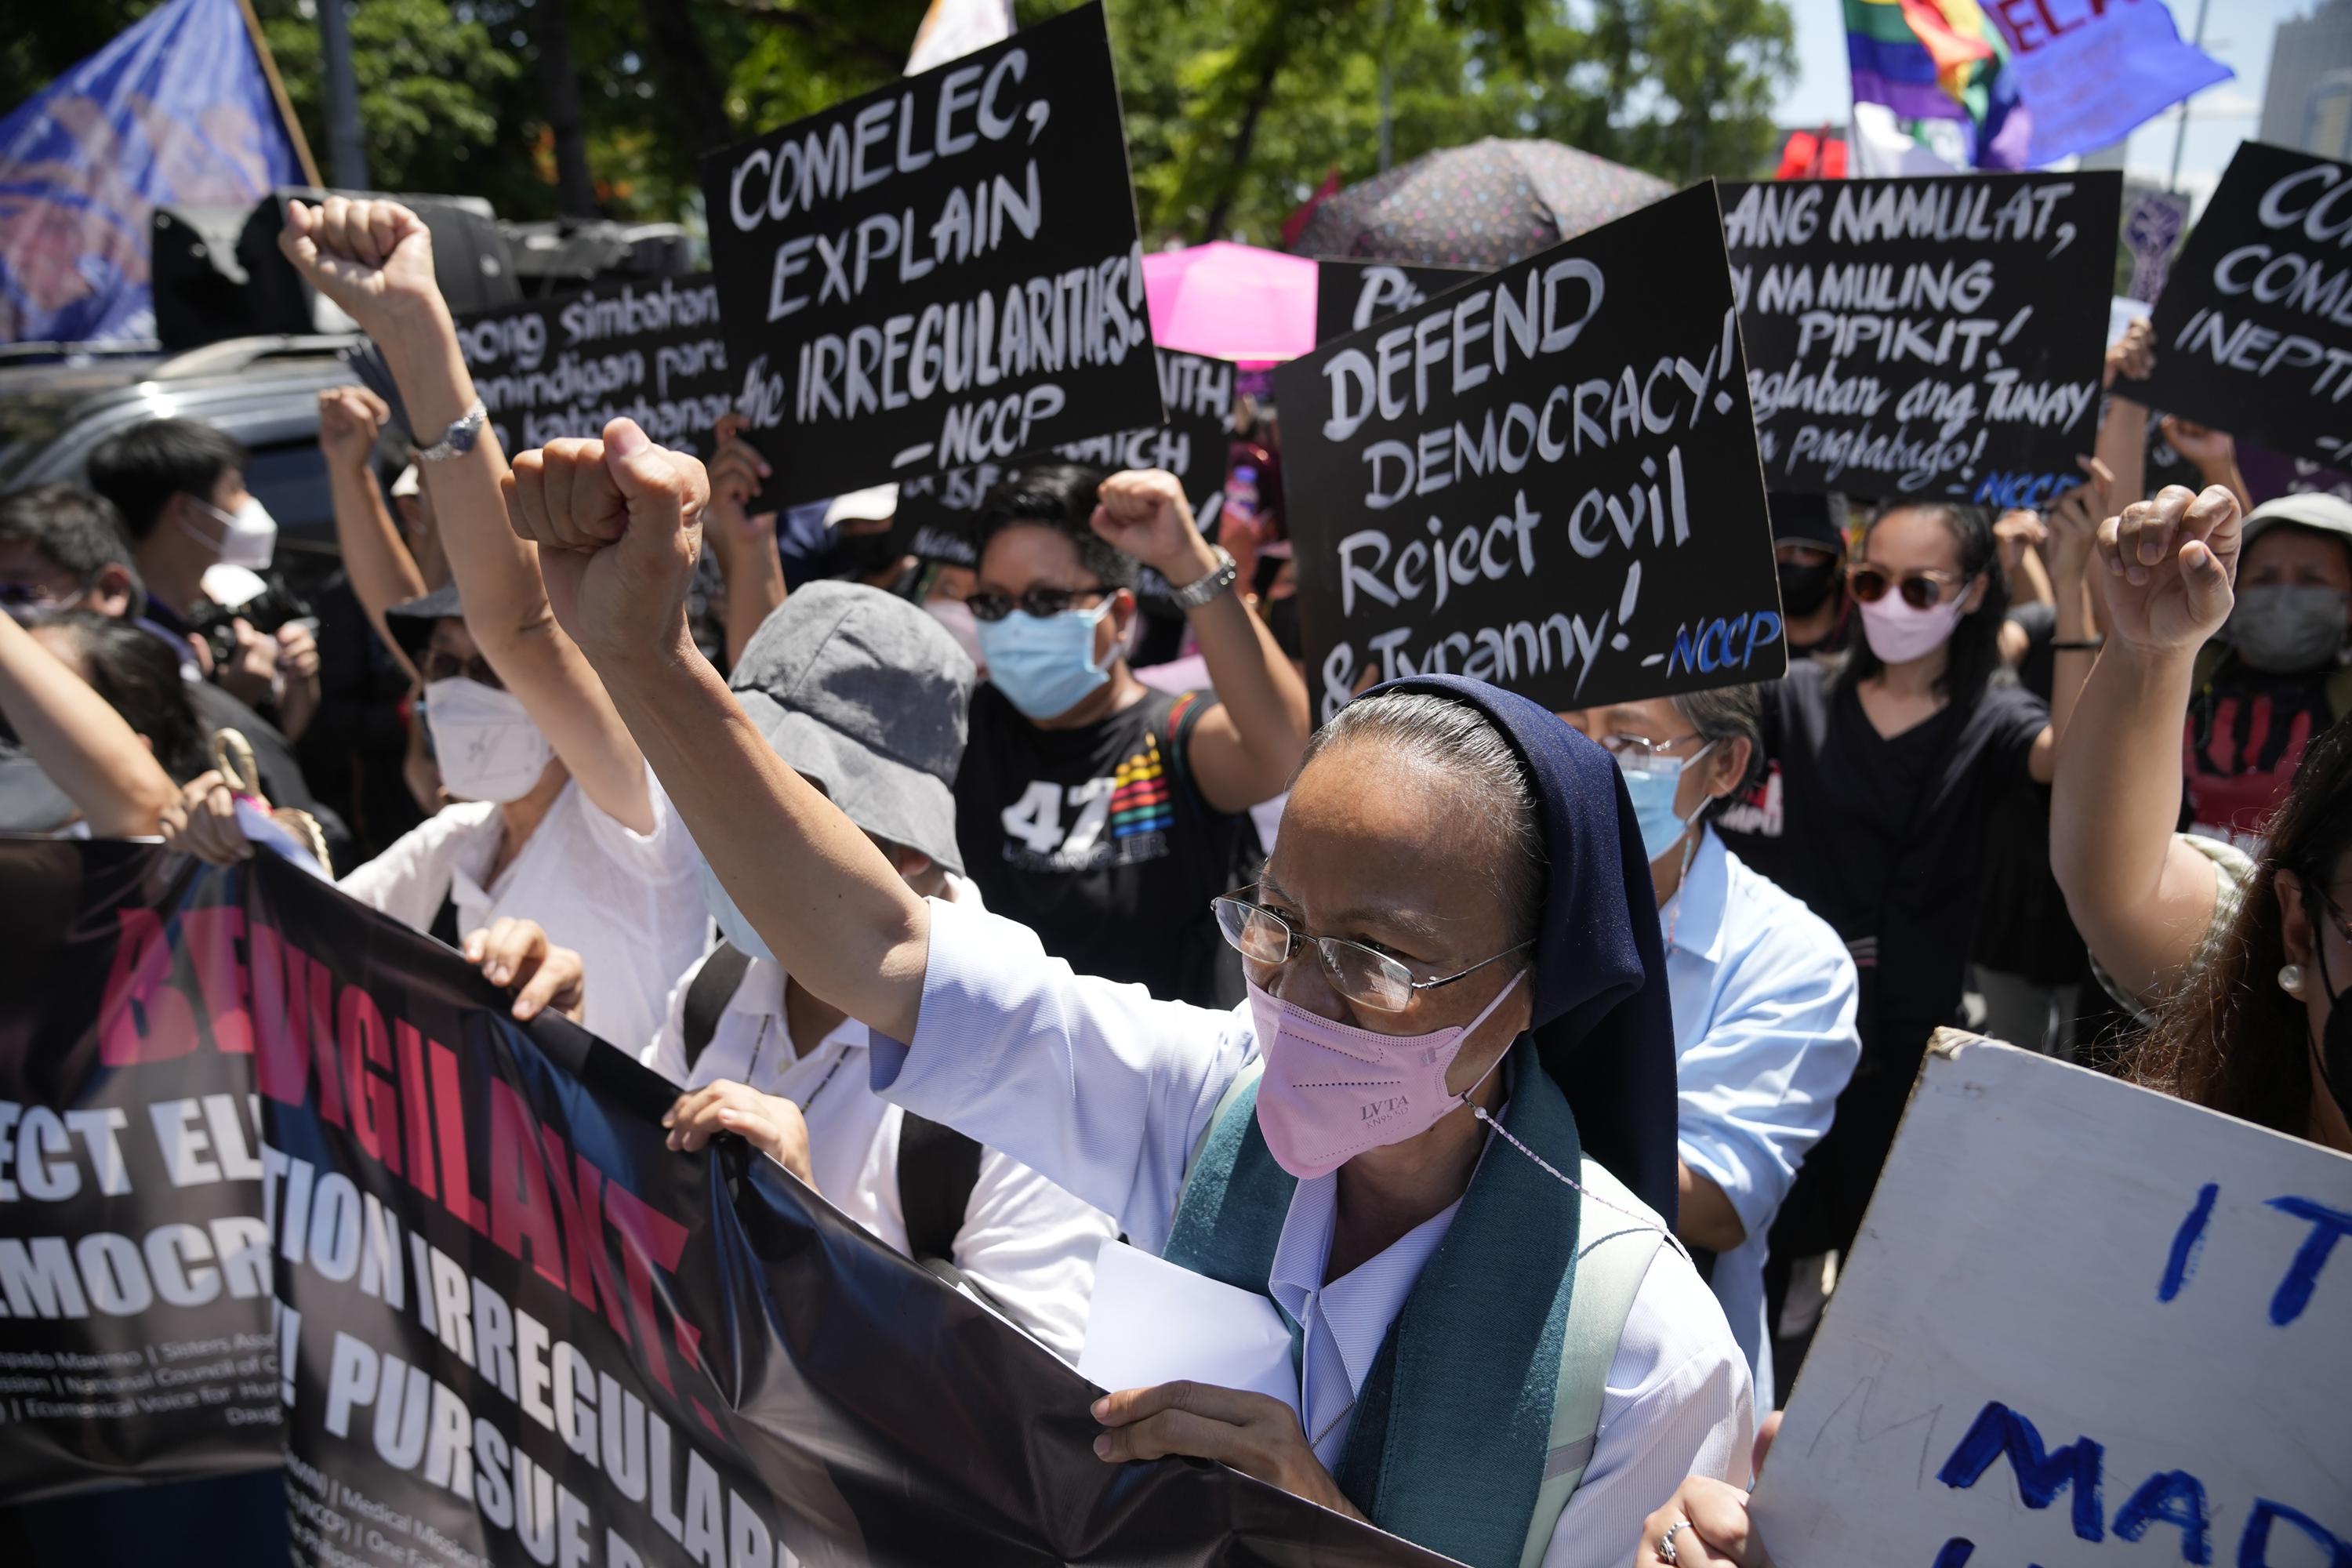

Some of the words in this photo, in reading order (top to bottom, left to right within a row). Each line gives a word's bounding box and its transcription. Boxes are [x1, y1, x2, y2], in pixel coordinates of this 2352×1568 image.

[1998, 0, 2140, 53] EL
[730, 48, 1051, 232] COMELEC,
[2258, 163, 2352, 249] CO
[767, 158, 1042, 323] EXPLAIN
[1724, 183, 1824, 250] ANG
[1829, 182, 2077, 260] NAMULAT,
[559, 278, 720, 347] simbahan
[735, 354, 784, 429] the
[796, 239, 1146, 424] IRREGULARITIES!
[1322, 257, 1605, 441] DEFEND
[1797, 305, 2034, 371] PIPIKIT!
[1363, 306, 1735, 509] DEMOCRACY!
[1895, 378, 1980, 443] ang
[1338, 488, 1541, 618] Reject
[1568, 445, 1690, 558] evil
[1321, 641, 1357, 724] &
[1368, 559, 1642, 700] Tyranny!
[1001, 776, 1117, 855] 47
[0, 1217, 273, 1319] MOCR
[410, 1229, 800, 1568] IRREGULAR
